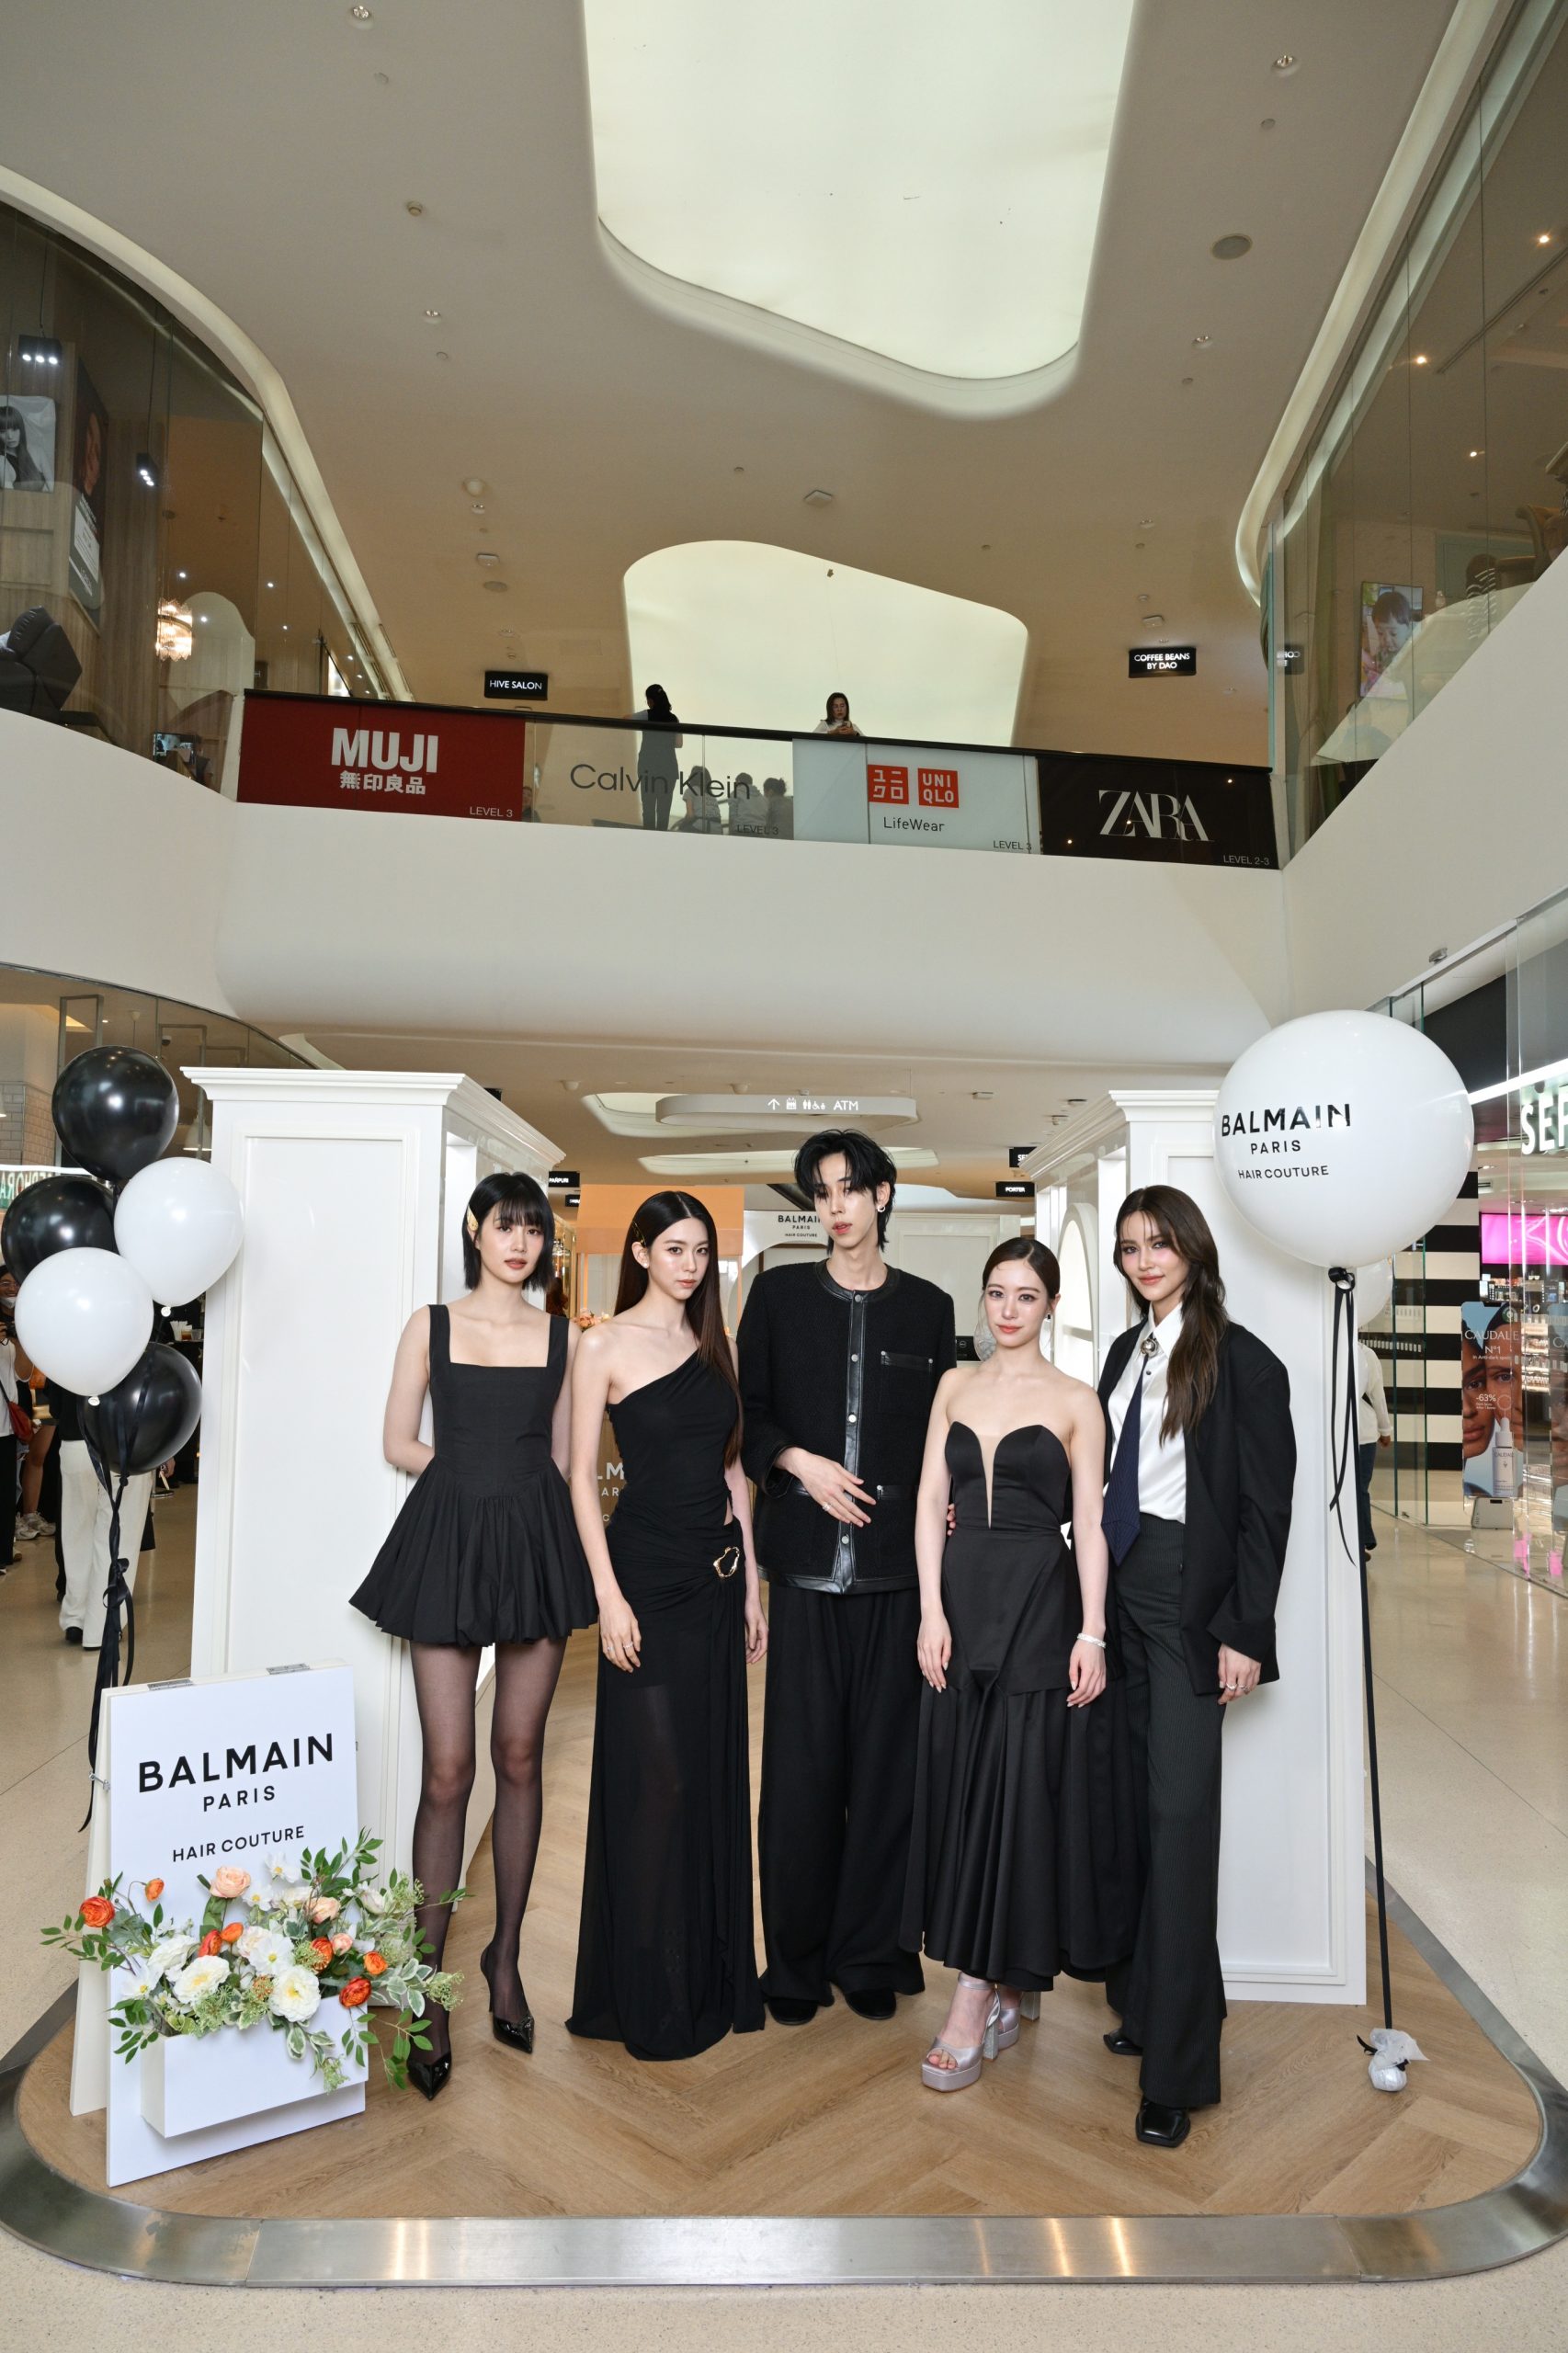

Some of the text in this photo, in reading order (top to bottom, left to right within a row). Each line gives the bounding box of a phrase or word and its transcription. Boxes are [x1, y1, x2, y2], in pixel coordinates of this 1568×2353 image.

[1133, 653, 1190, 662] COFFEE BEANS
[1158, 661, 1177, 670] DAO
[489, 679, 542, 690] HIVE SALON
[331, 727, 438, 773] MUJI
[339, 770, 426, 795] 無印良品
[570, 763, 751, 800] Calvin Klein
[922, 772, 951, 788] UNI
[923, 788, 954, 803] QLO
[469, 806, 513, 818] LEVEL 3
[1098, 789, 1214, 842] ZARA
[736, 824, 779, 835] LEVEL 3
[883, 816, 945, 832] LifeWear
[993, 840, 1024, 851] LEVEL
[1223, 855, 1270, 866] LEVEL 2-3
[833, 1100, 859, 1111] ATM
[1221, 1103, 1351, 1137] BALMAIN
[1250, 1140, 1301, 1154] PARIS
[1238, 1165, 1329, 1179] HAIR COUTURE
[778, 1214, 821, 1222] BALMAI
[1464, 1330, 1519, 1341] CAUDALE
[1475, 1393, 1496, 1402] -63%
[139, 1733, 333, 1793] BALMAIN
[203, 1785, 275, 1813] PARIS
[173, 1825, 304, 1863] HAIR COUTURE
